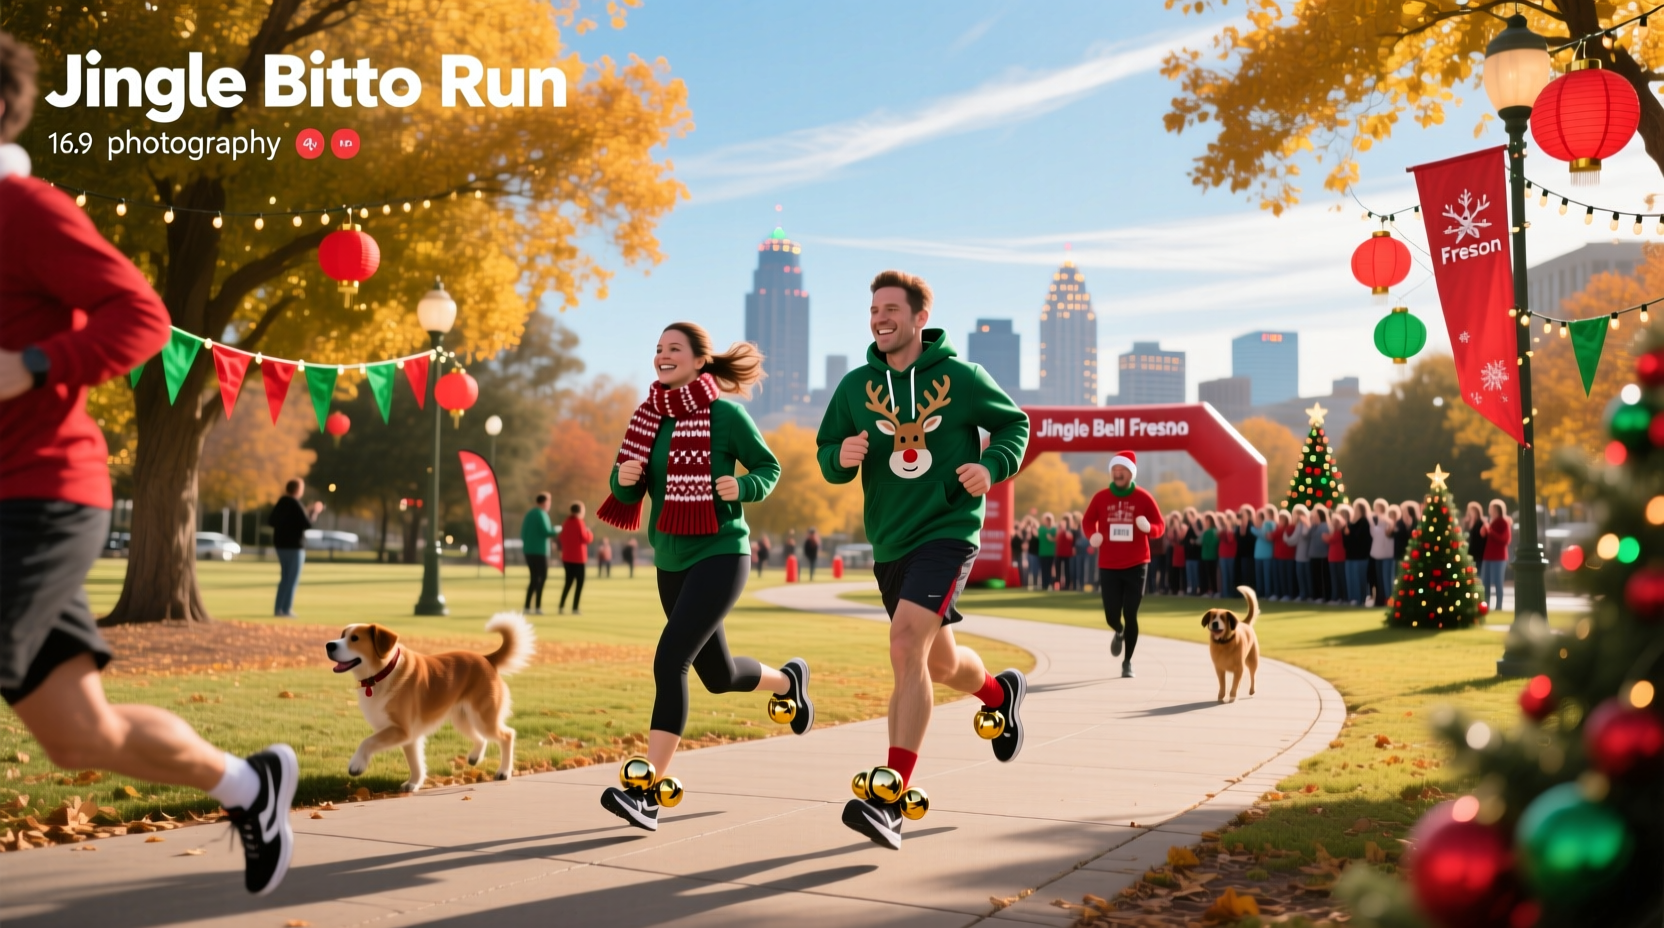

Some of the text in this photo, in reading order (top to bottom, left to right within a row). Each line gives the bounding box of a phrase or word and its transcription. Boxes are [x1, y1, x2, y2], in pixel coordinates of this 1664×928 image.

[1441, 237, 1502, 265] Freson
[1036, 418, 1090, 442] Jingle
[1092, 418, 1125, 437] Bell
